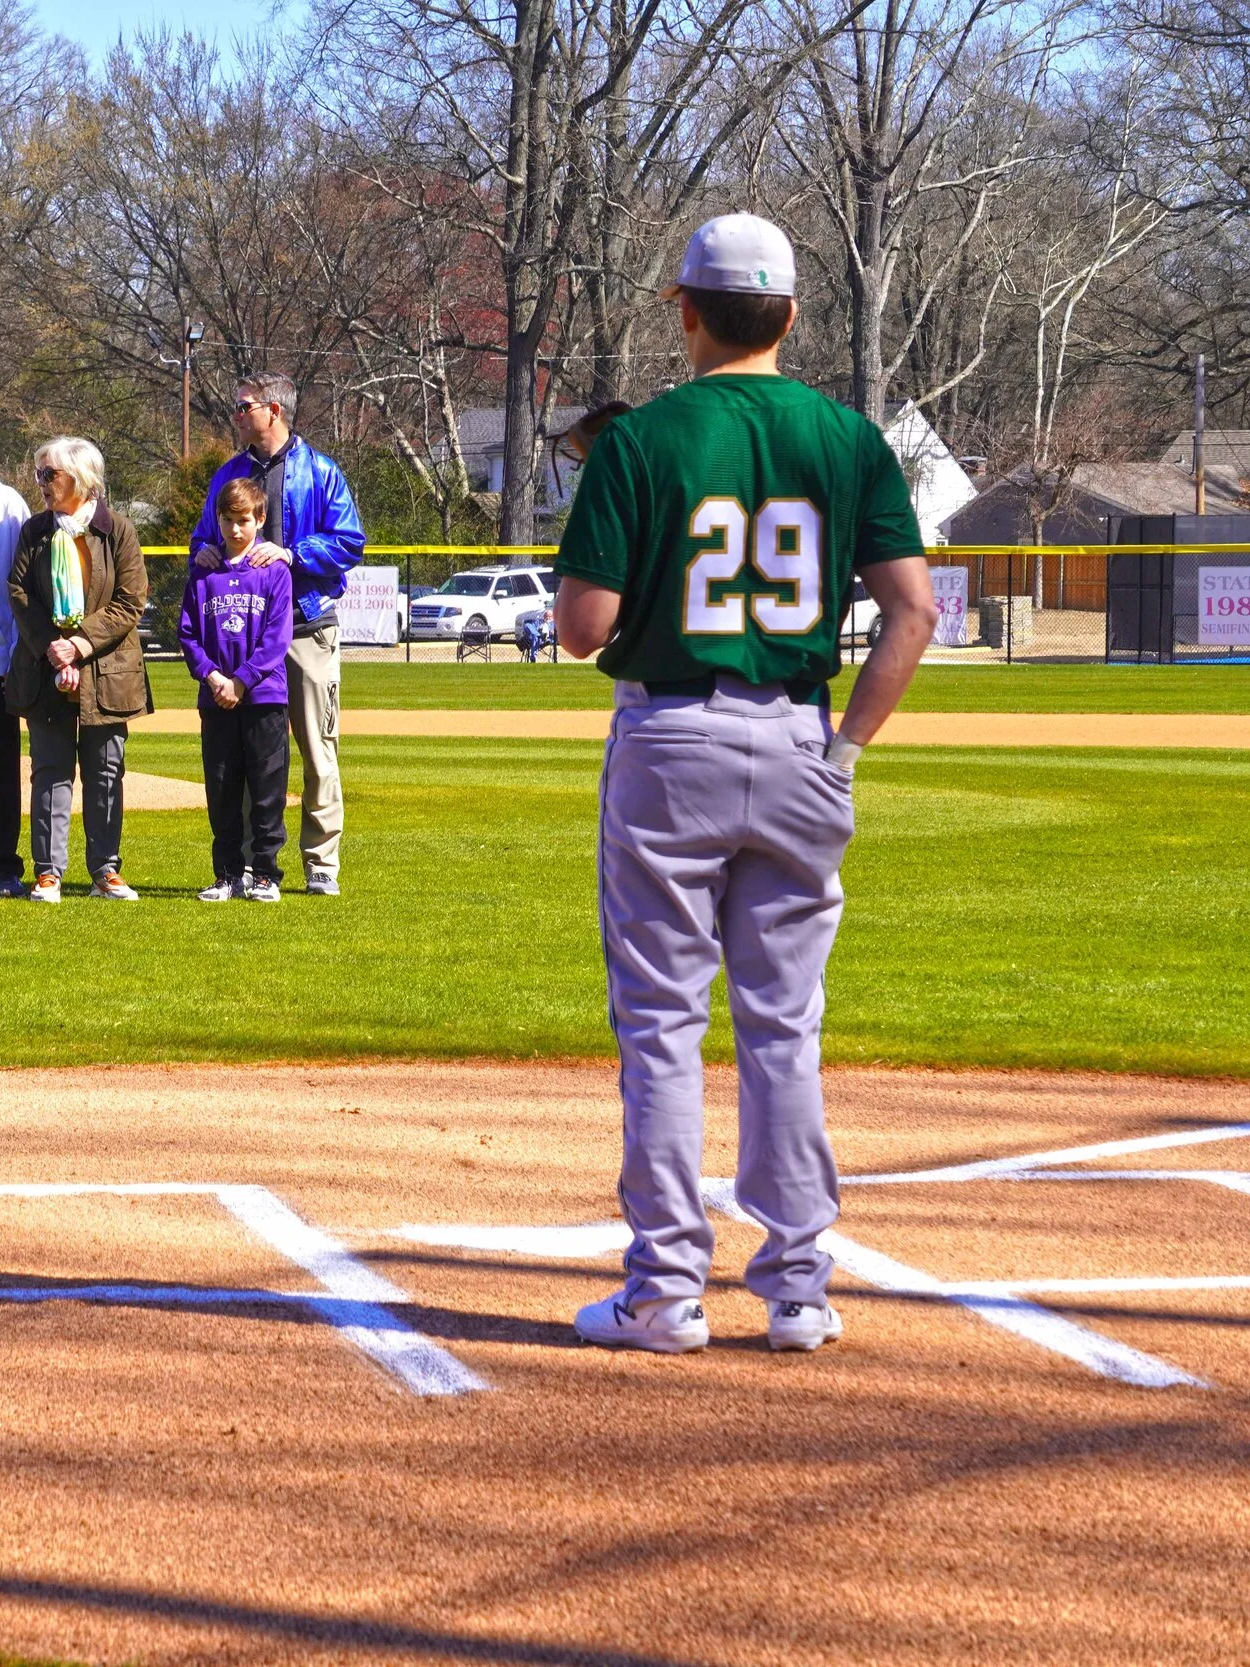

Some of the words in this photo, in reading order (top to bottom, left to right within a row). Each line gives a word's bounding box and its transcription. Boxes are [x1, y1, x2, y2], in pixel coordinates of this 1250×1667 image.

[682, 496, 823, 635] 29
[366, 584, 394, 596] 1990
[365, 599, 393, 610] 2016
